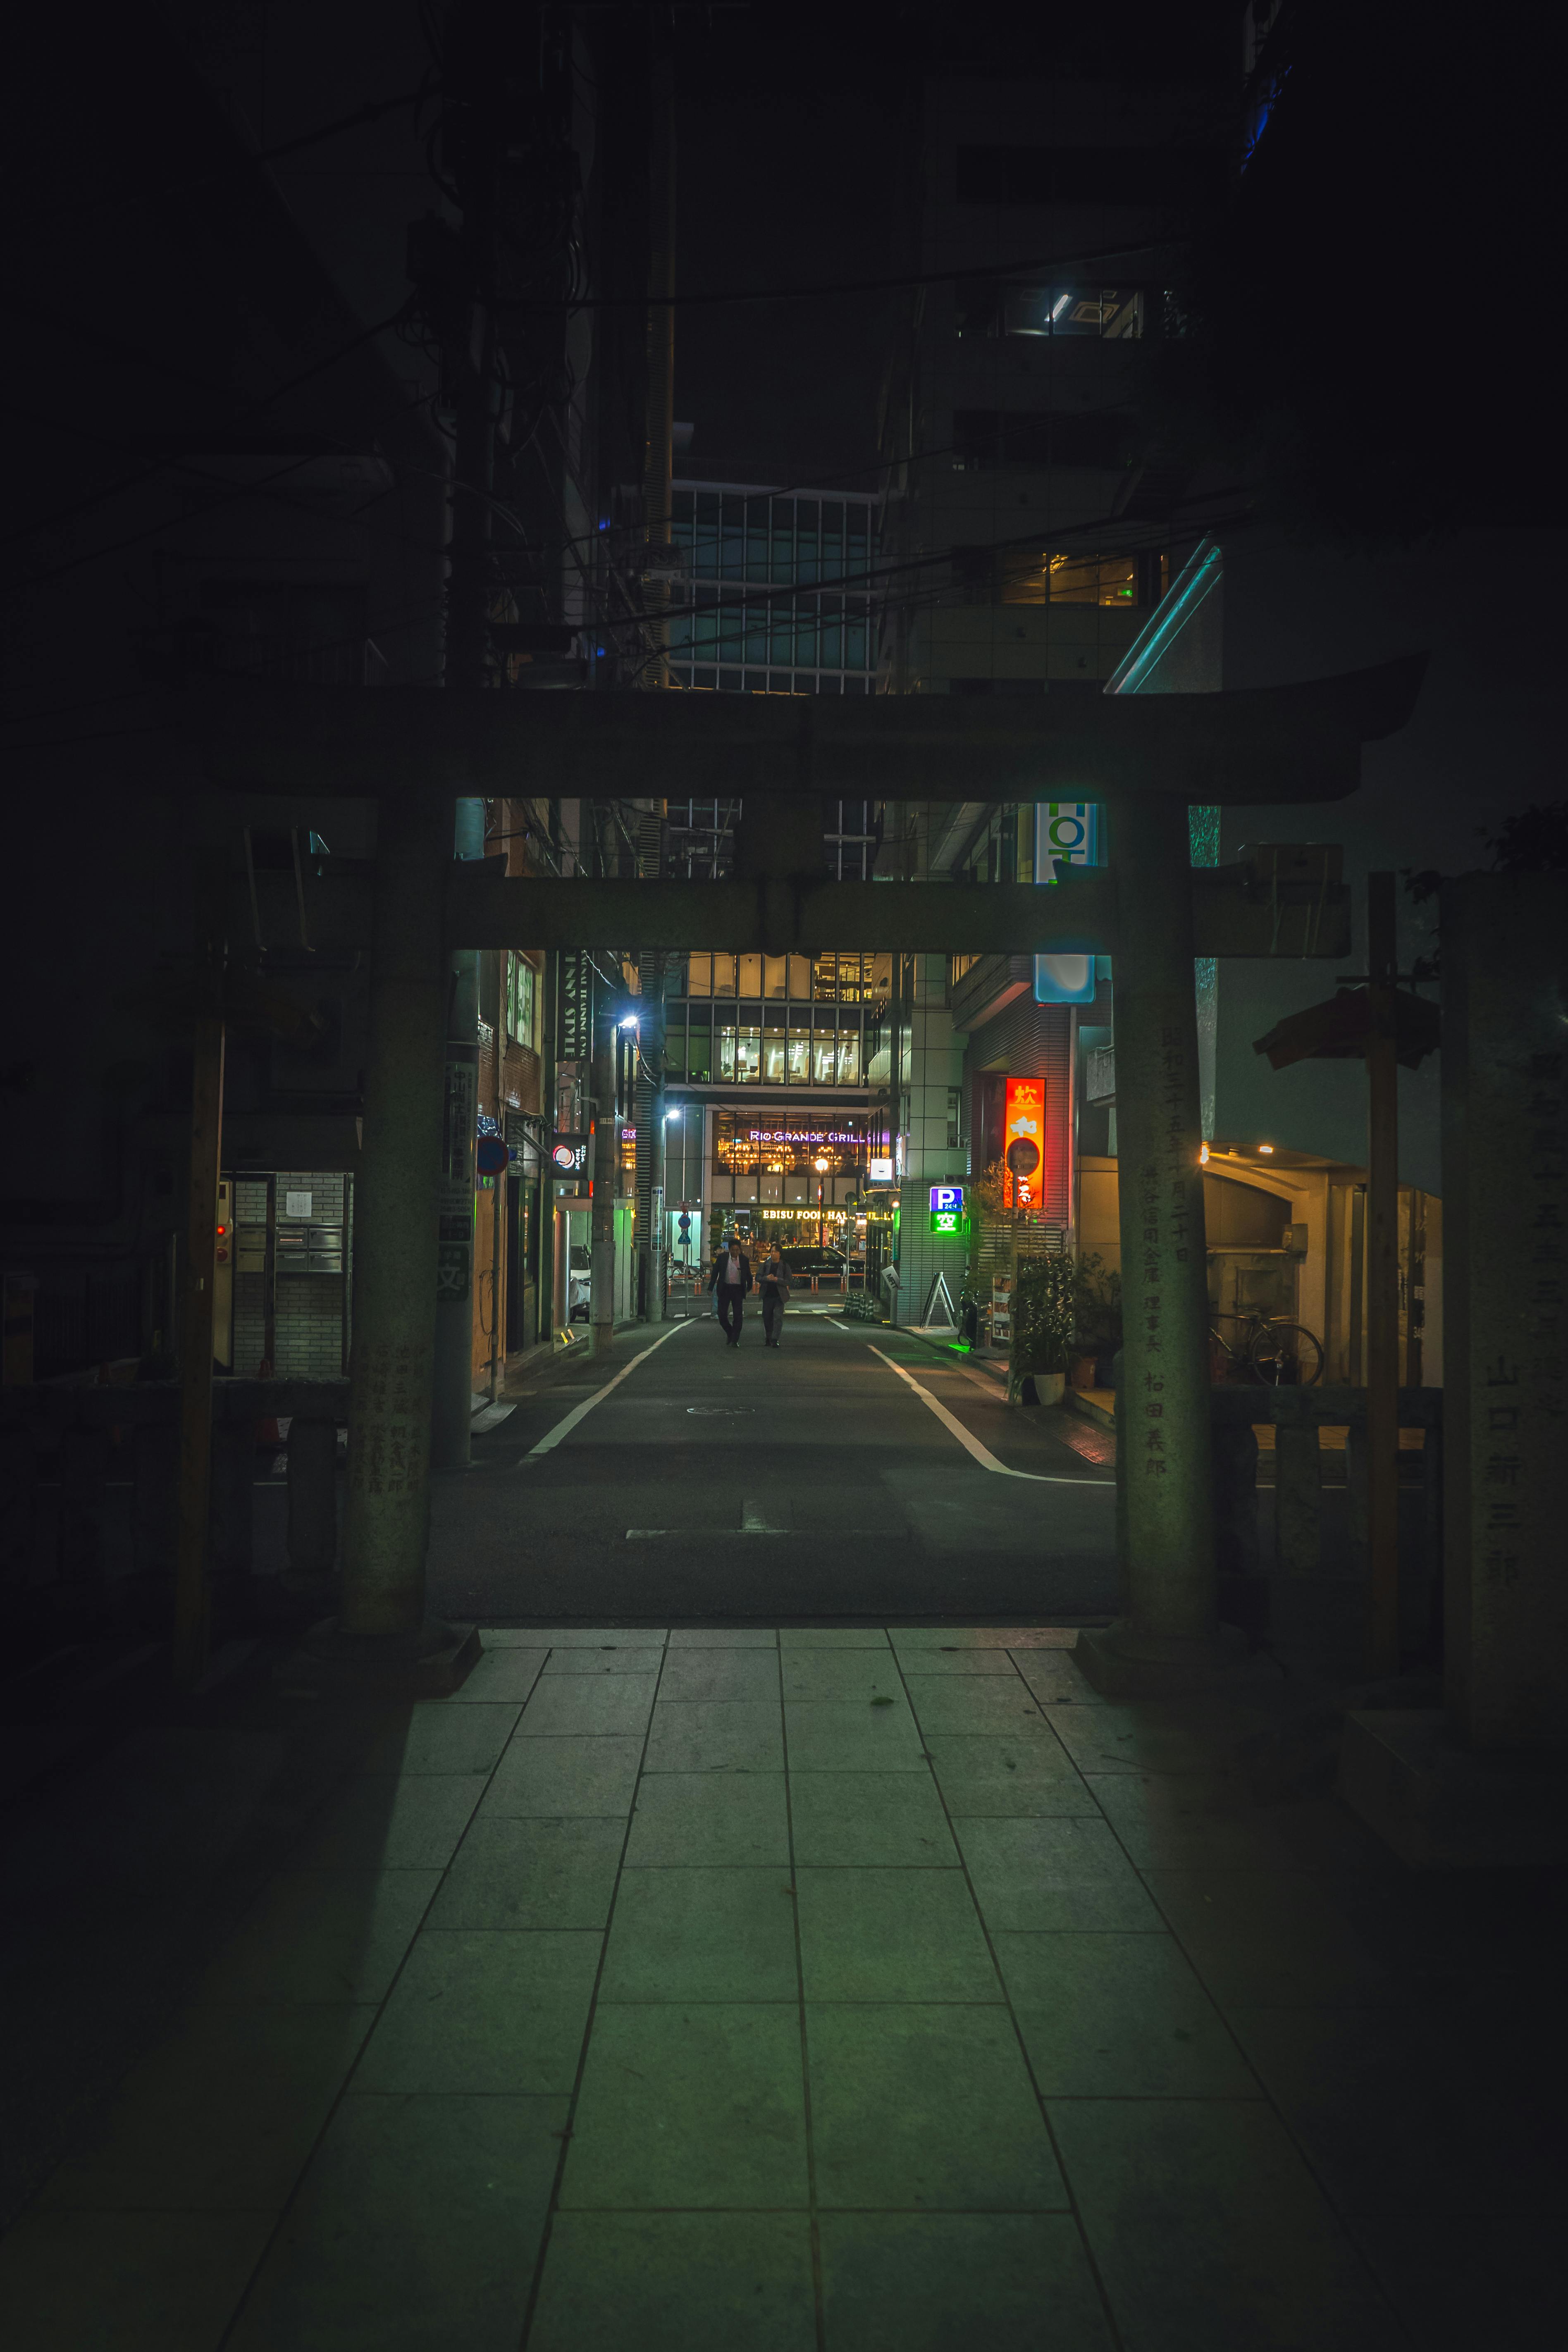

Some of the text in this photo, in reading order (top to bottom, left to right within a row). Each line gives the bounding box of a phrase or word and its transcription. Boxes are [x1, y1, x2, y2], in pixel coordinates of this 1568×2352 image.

[564, 1008, 575, 1057] STYLE
[938, 1189, 955, 1209] P
[763, 1210, 794, 1219] EBISU
[937, 1212, 956, 1231] 空
